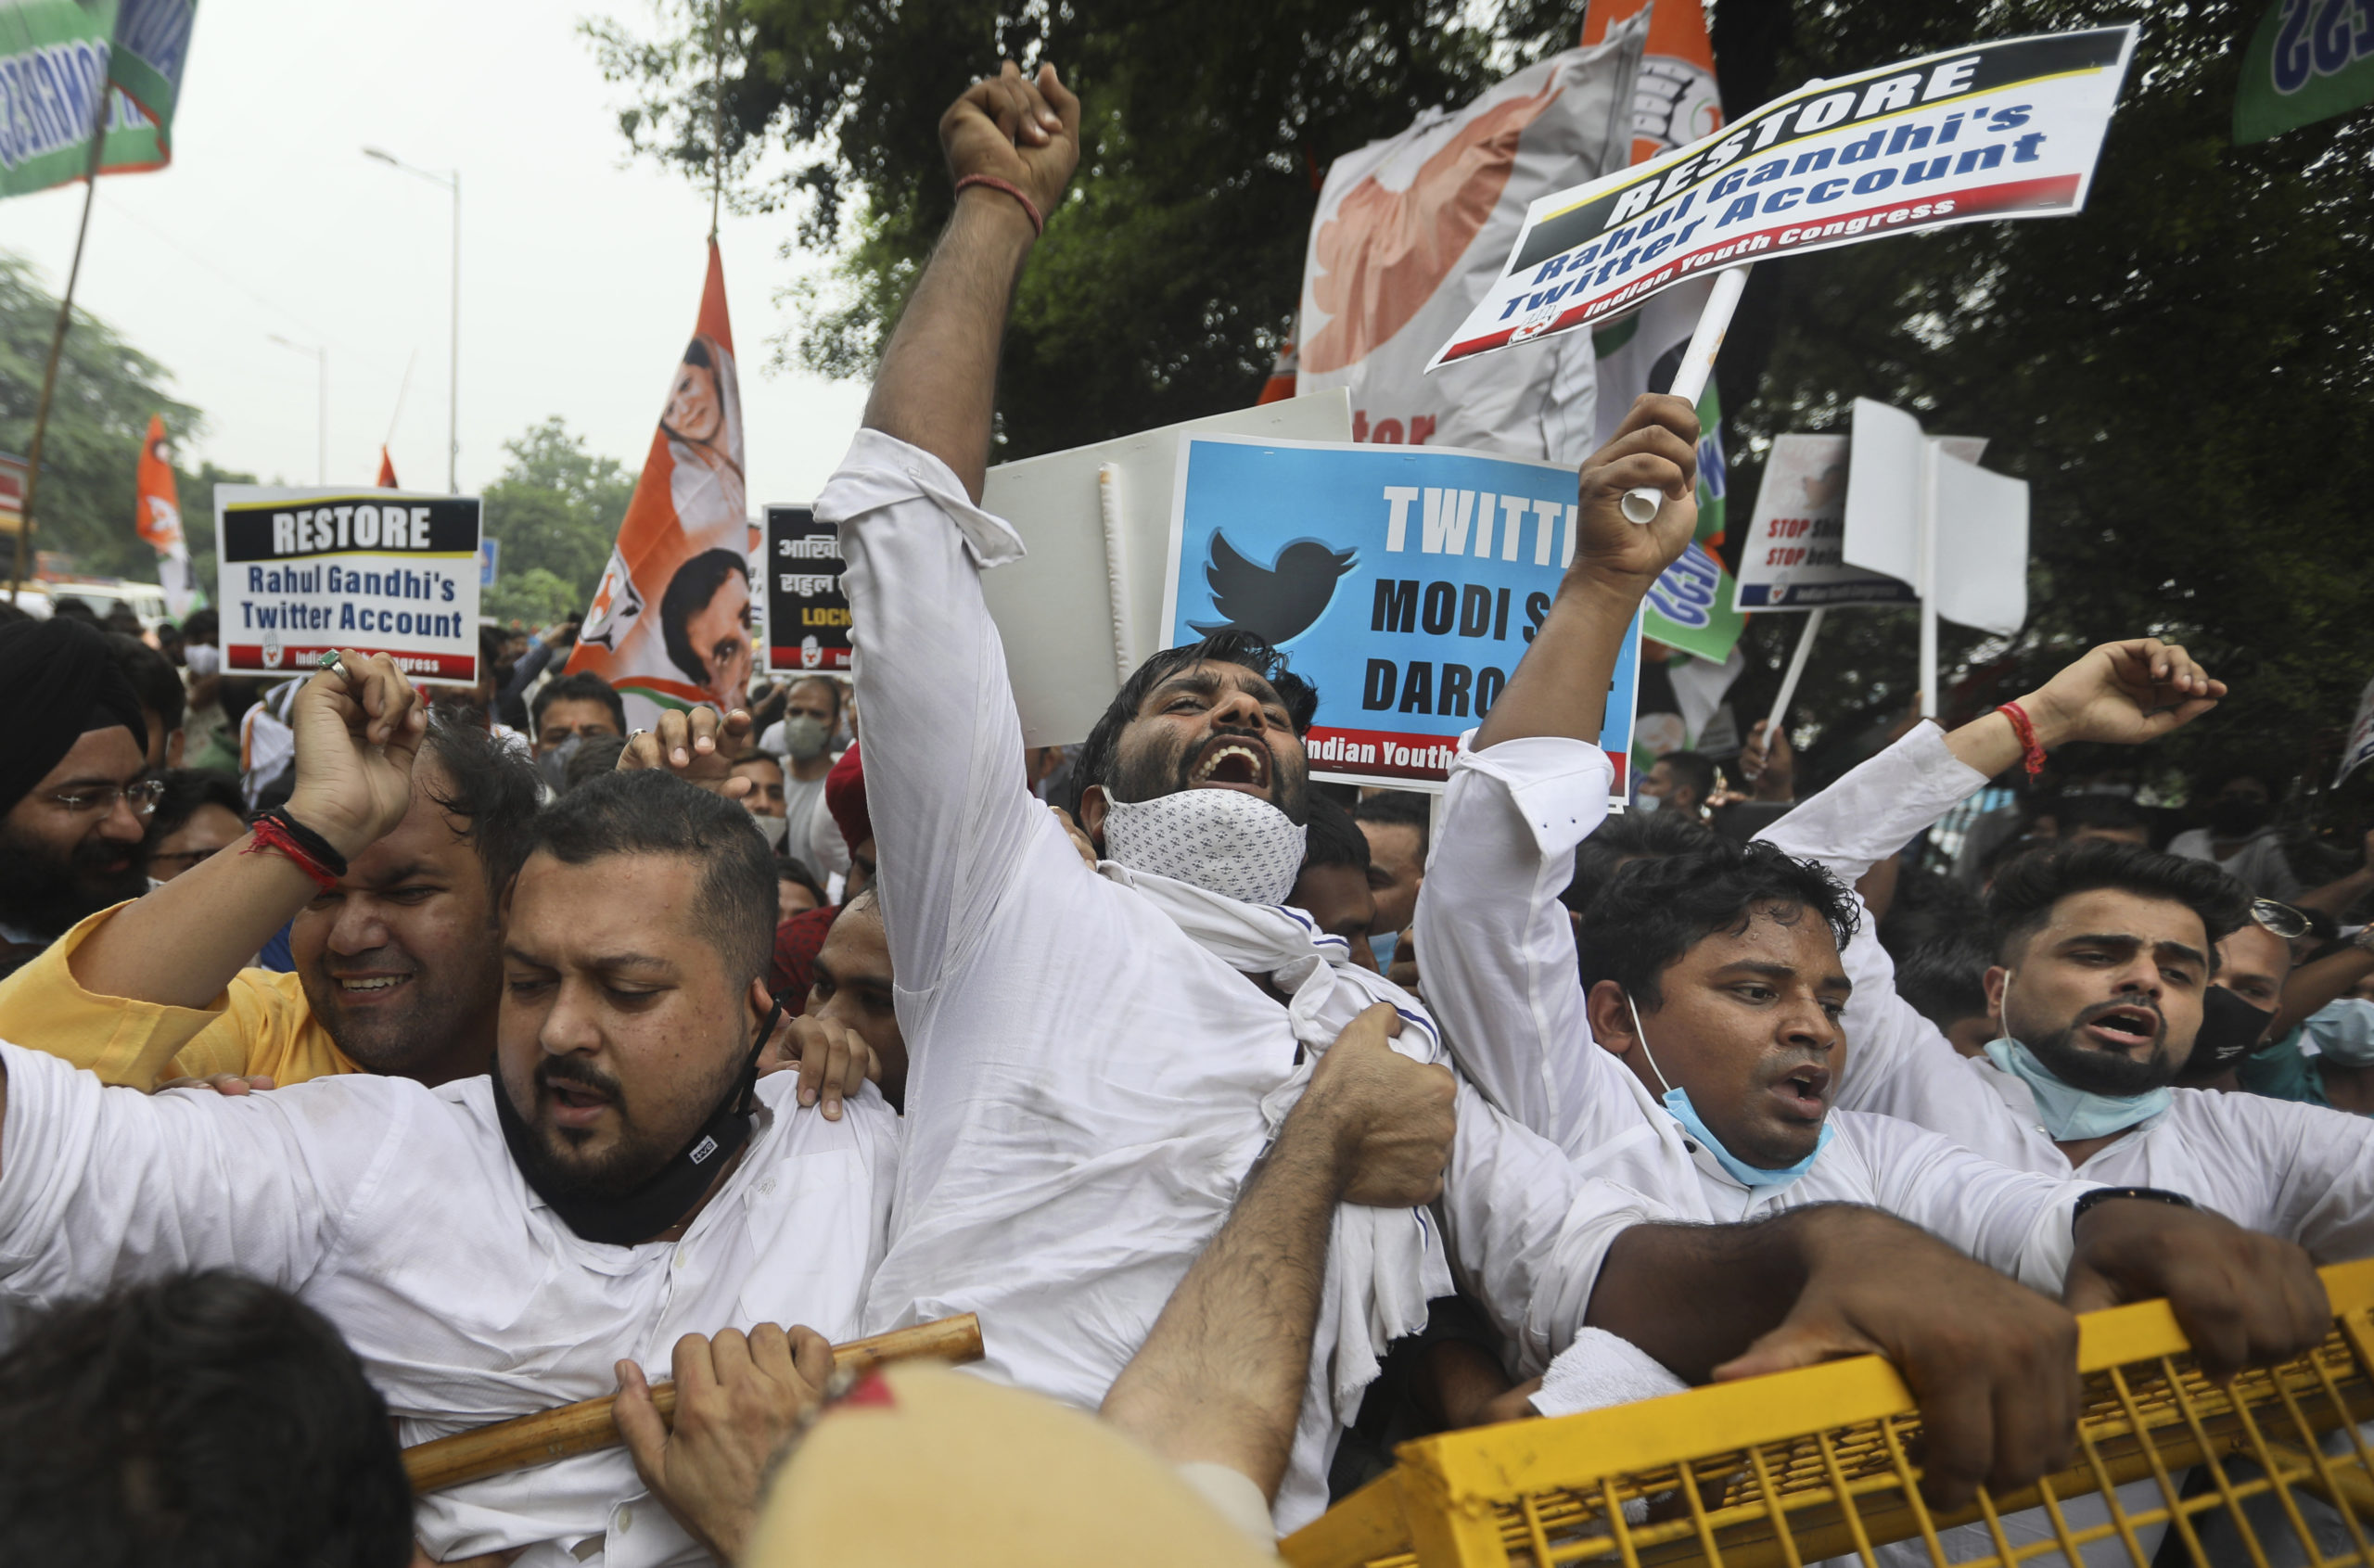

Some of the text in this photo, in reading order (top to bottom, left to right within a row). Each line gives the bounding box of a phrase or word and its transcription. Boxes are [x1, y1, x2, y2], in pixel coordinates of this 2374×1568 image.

[1603, 56, 1981, 230] RESTORE
[1531, 104, 2033, 286] Rahul Gandhi's
[1498, 132, 2047, 321] Twitter Account
[1582, 198, 1956, 318] Indian Youth Congress
[273, 505, 431, 555] RESTORE
[778, 534, 838, 558] आखि
[1384, 486, 1577, 568] TWITT
[1767, 518, 1810, 538] STOP
[1766, 547, 1806, 567] STOP
[248, 564, 455, 603] Rahul Gandhi's
[779, 574, 834, 597] राहुल
[241, 601, 462, 639] Twitter Account
[801, 607, 852, 627] LOCK
[1371, 579, 1551, 644] MODI S
[295, 650, 440, 673] Indi ngress
[1362, 658, 1506, 719] DARO
[1383, 741, 1454, 770] Youth
